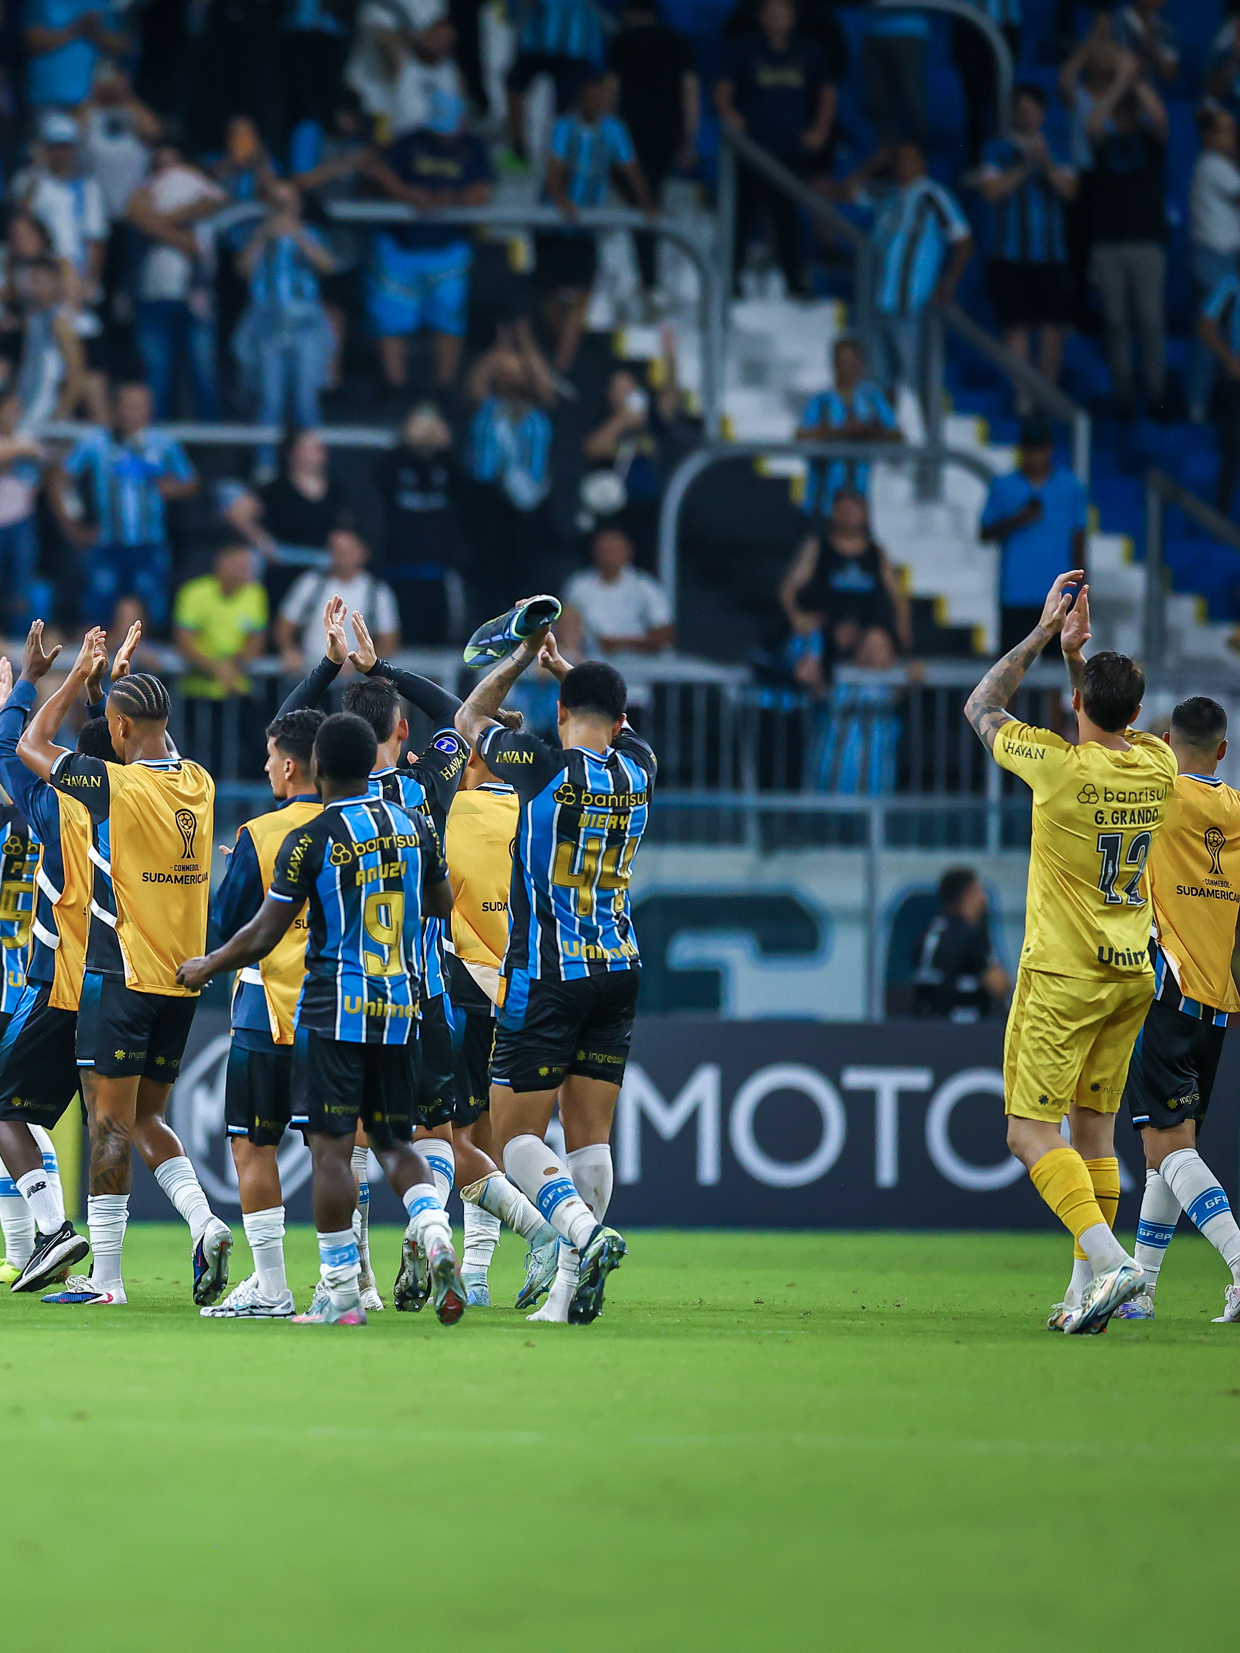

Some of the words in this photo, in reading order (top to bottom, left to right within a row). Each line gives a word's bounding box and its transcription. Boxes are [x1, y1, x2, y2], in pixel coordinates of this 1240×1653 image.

[1006, 742, 1046, 760] HAVAN
[439, 749, 466, 781] HAVAN
[60, 773, 103, 788] HAVAN
[580, 790, 648, 807] banrisul
[1104, 784, 1167, 803] banrisul
[1111, 808, 1159, 825] GRANDO
[352, 832, 420, 856] banrisul
[286, 833, 314, 883] HAVAN
[1096, 831, 1152, 905] 12
[551, 836, 638, 917] 44
[364, 890, 406, 977] 9
